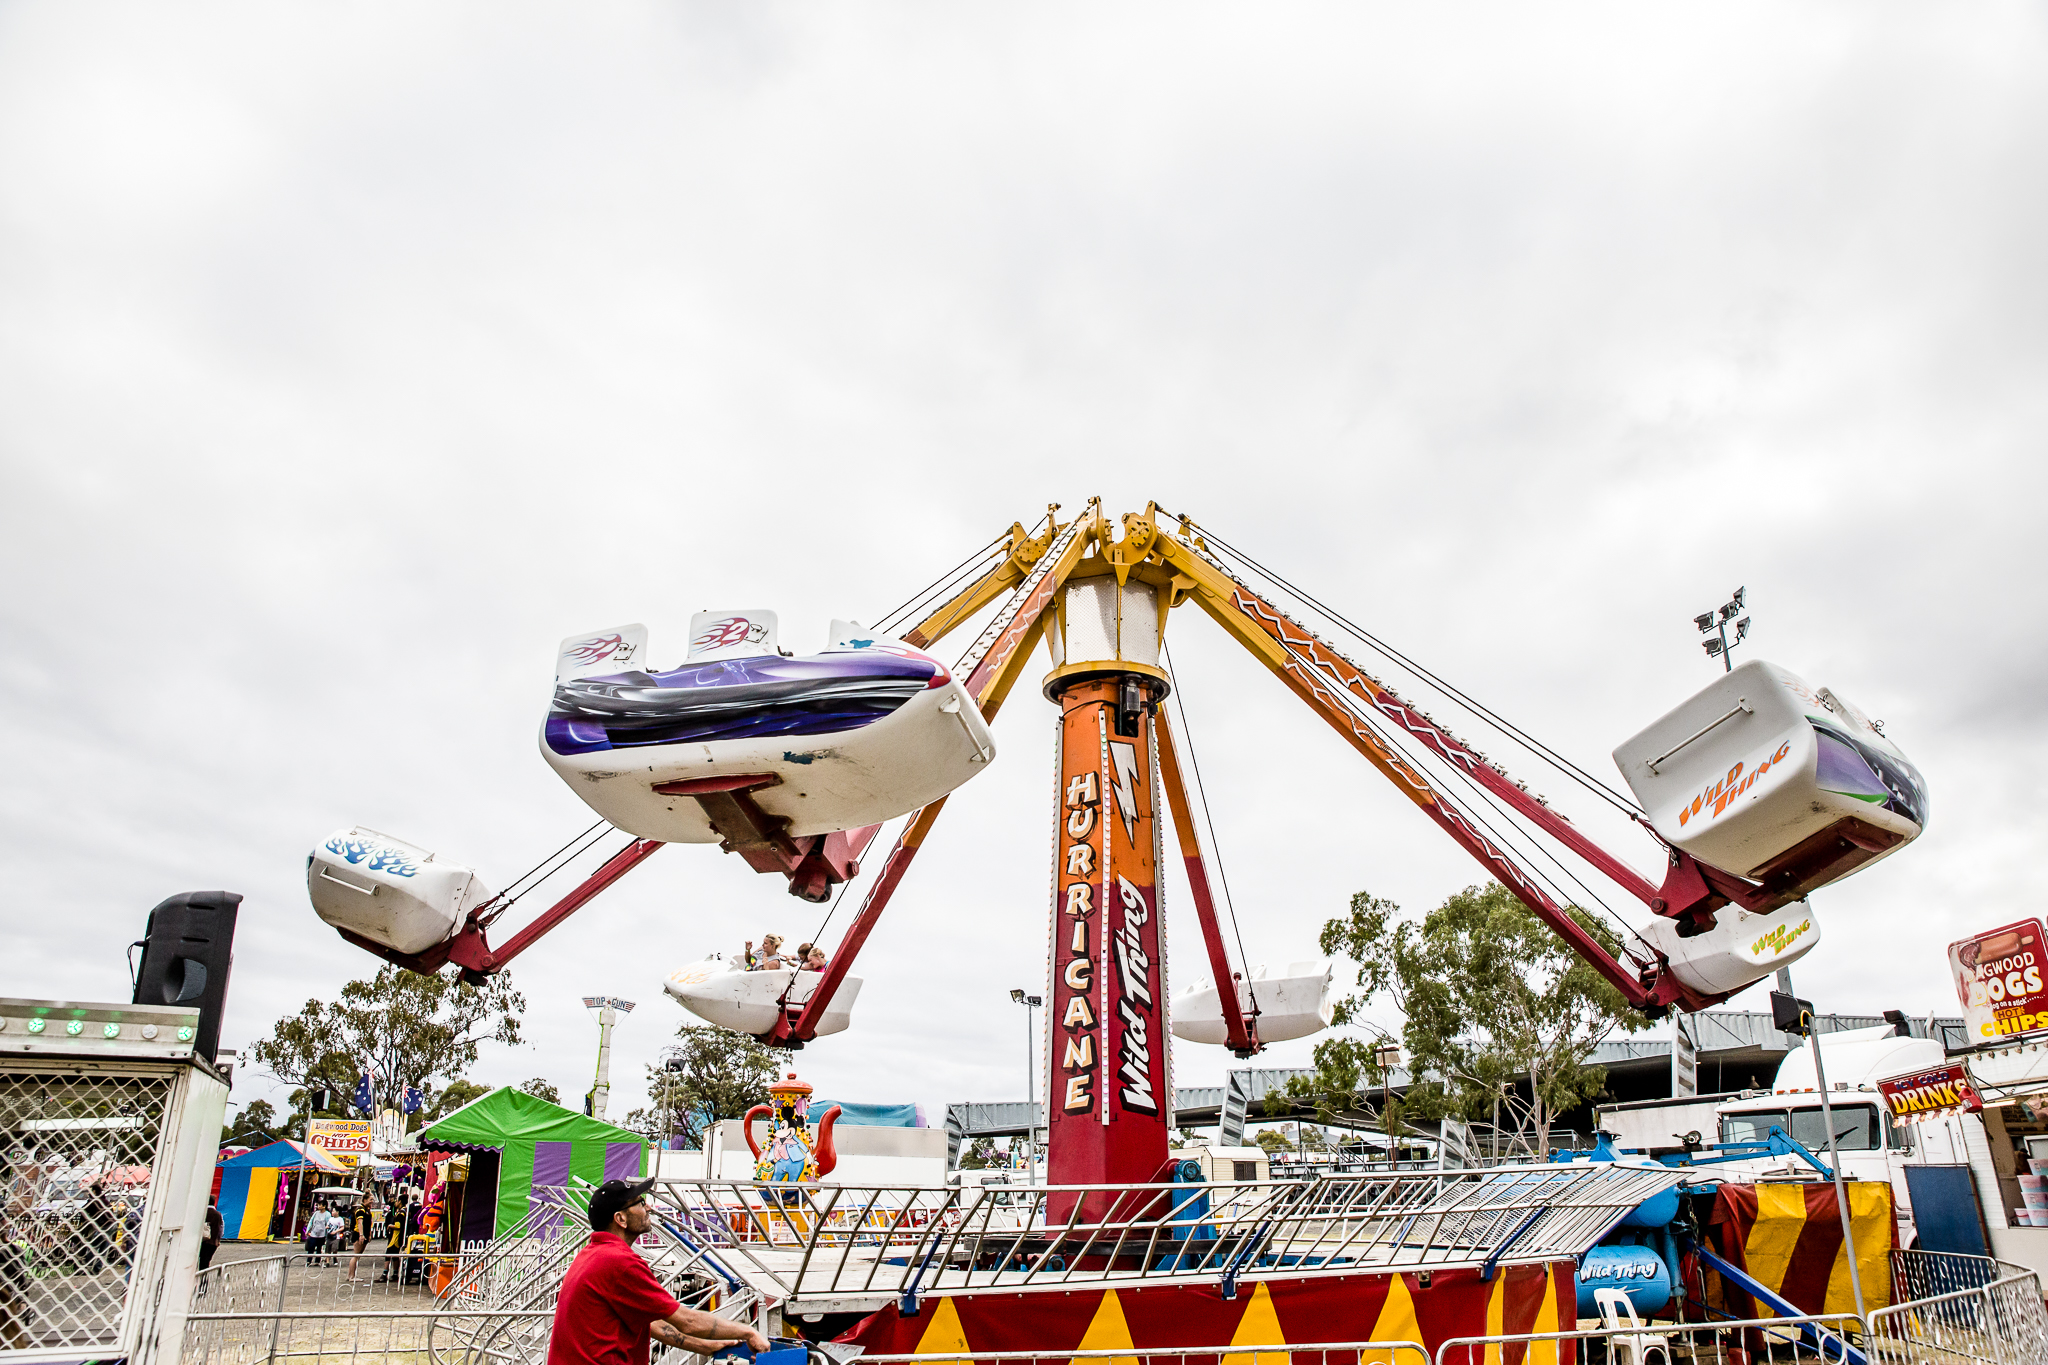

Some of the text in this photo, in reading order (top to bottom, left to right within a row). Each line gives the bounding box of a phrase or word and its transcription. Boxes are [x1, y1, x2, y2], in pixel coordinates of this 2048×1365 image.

[1710, 739, 1791, 820] THING
[1679, 761, 1744, 828] WILD
[1063, 771, 1100, 1112] HURRICANE
[1751, 924, 1786, 956] WILD
[1770, 919, 1811, 956] THING
[1114, 870, 1158, 1113] Wild Thing
[1968, 965, 2044, 1008] DOGS
[592, 996, 626, 1009] TOP GUN
[1997, 1007, 2020, 1019] HOT
[1980, 1011, 2048, 1037] CHIPS
[1894, 1070, 1950, 1091] ICY COLD
[310, 1134, 369, 1149] CHIPS
[350, 1123, 368, 1132] Dogs
[1580, 1260, 1658, 1283] Wild Thing
